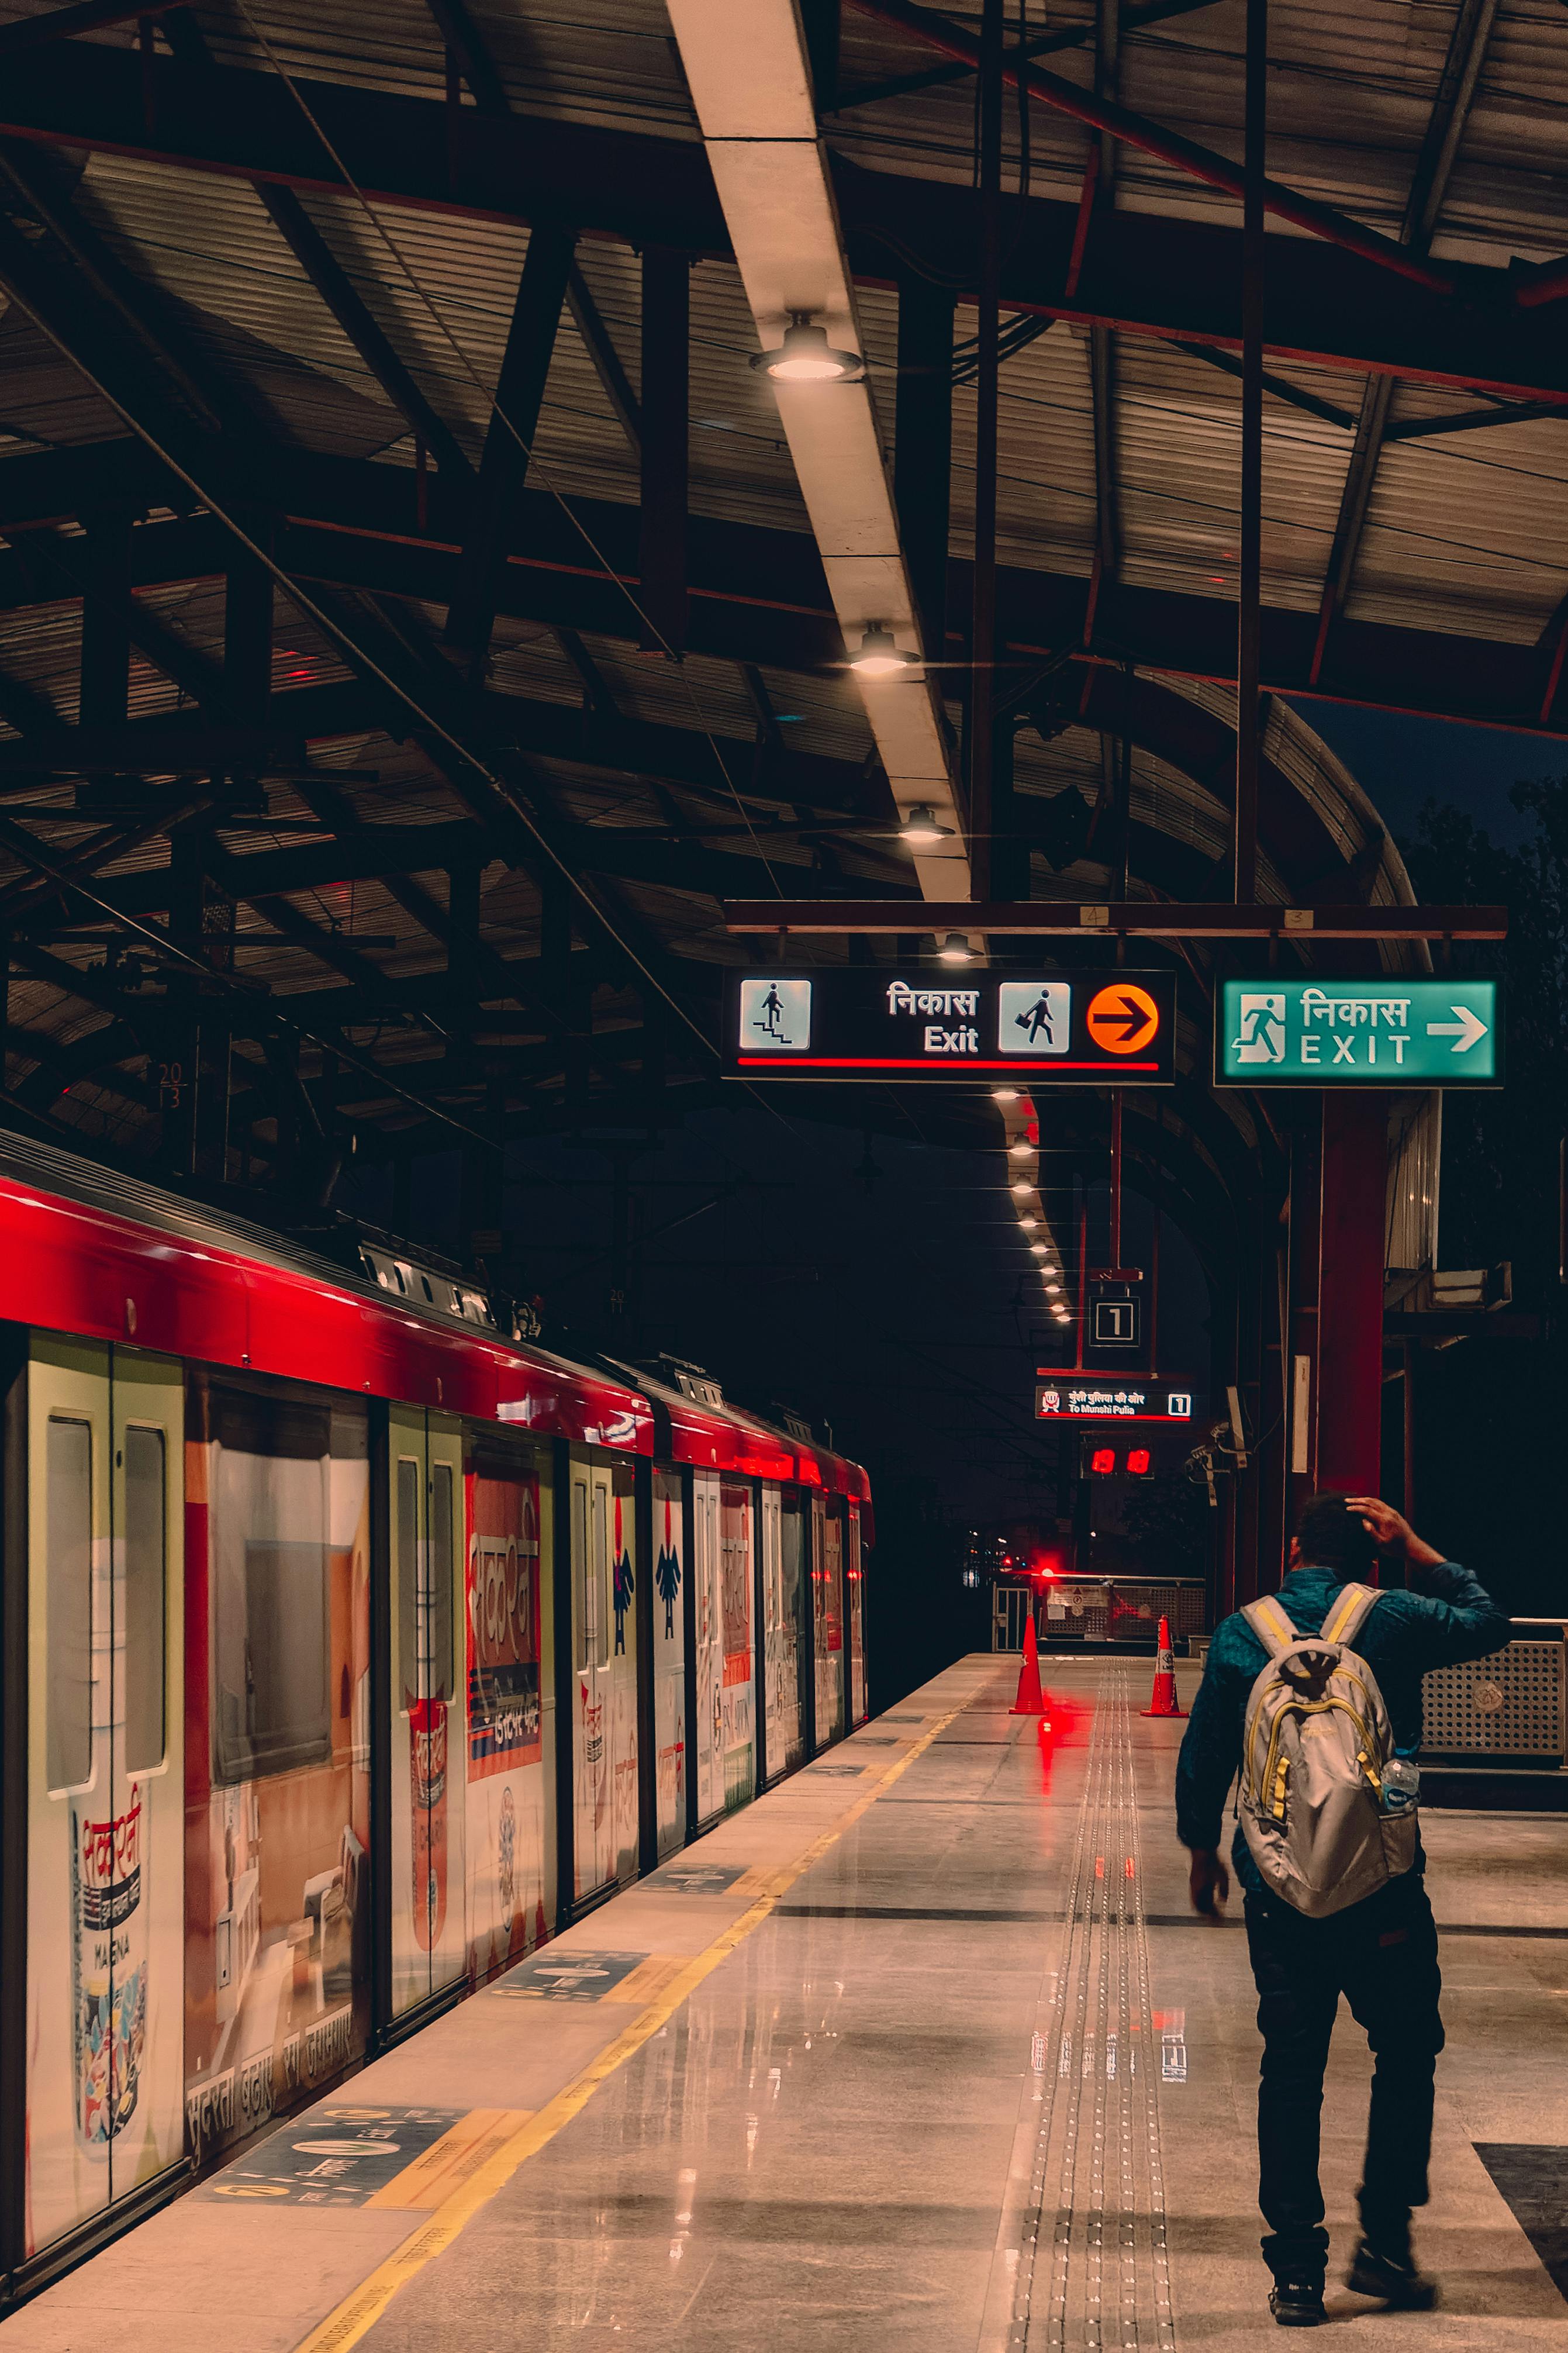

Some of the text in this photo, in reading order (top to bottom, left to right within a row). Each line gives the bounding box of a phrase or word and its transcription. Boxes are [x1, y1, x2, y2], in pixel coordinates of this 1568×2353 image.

[886, 981, 980, 1016] निकास
[1299, 987, 1411, 1027] निकास
[924, 1025, 979, 1053] Exit
[1300, 1035, 1411, 1064] EXIT
[158, 1062, 182, 1085] 20
[1109, 1308, 1121, 1336] 1
[1069, 1405, 1135, 1415] To Munshi Pulia
[1175, 1398, 1184, 1413] 1
